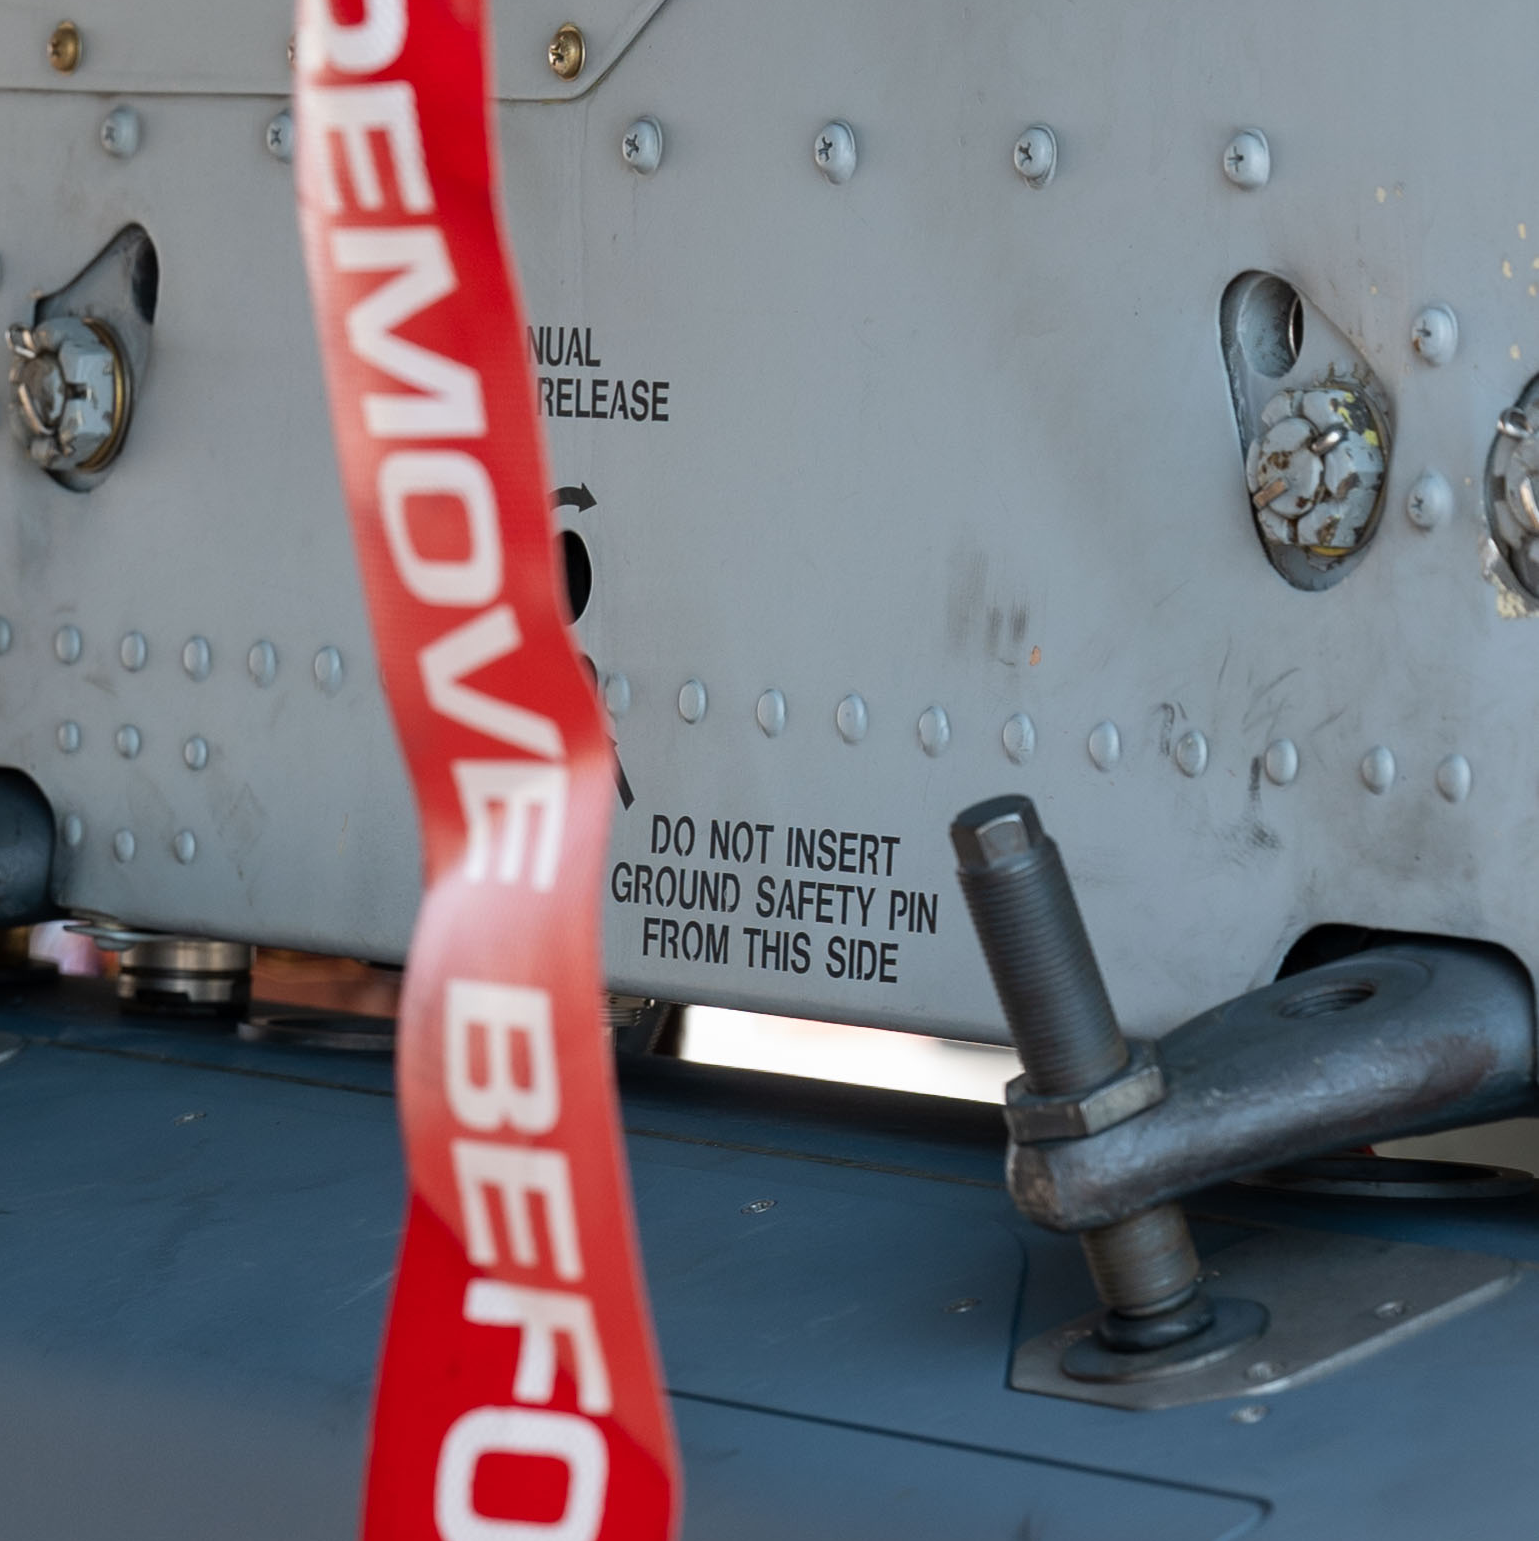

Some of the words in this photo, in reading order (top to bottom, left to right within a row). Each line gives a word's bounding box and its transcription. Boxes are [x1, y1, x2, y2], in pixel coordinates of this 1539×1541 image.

[528, 325, 601, 368] NUAL
[538, 376, 670, 422] RELEASE
[651, 814, 696, 858] DO
[709, 819, 775, 865] NOT
[786, 826, 901, 878] INSERT
[611, 861, 741, 914] GROUND
[755, 875, 876, 928] SAFETY
[888, 889, 939, 936] PIN
[642, 916, 730, 966] FROM
[742, 927, 811, 976] THIS
[825, 935, 899, 985] SIDE
